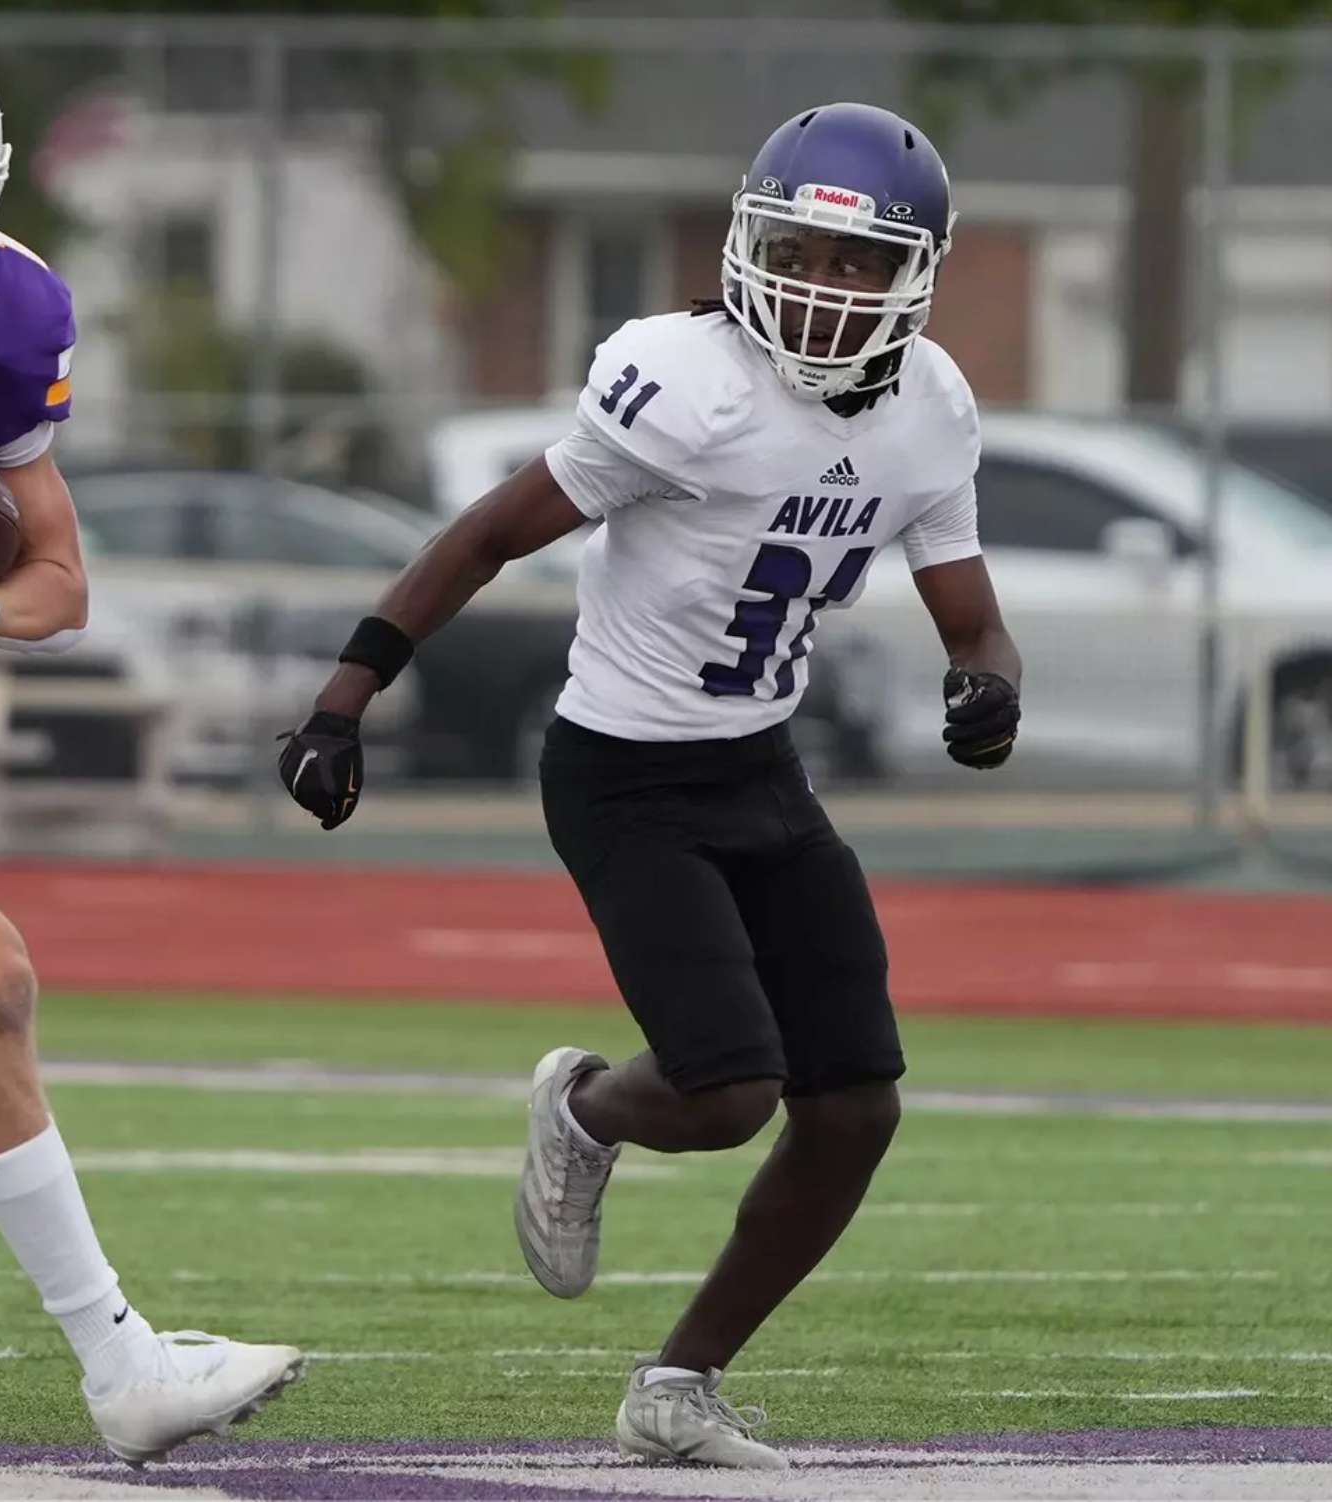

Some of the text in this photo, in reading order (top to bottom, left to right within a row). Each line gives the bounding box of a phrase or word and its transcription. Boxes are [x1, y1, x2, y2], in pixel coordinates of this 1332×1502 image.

[813, 187, 859, 208] Riddell
[599, 363, 663, 431] 31
[819, 474, 861, 487] adidas
[767, 496, 883, 538] AVILA
[698, 543, 876, 700] 31
